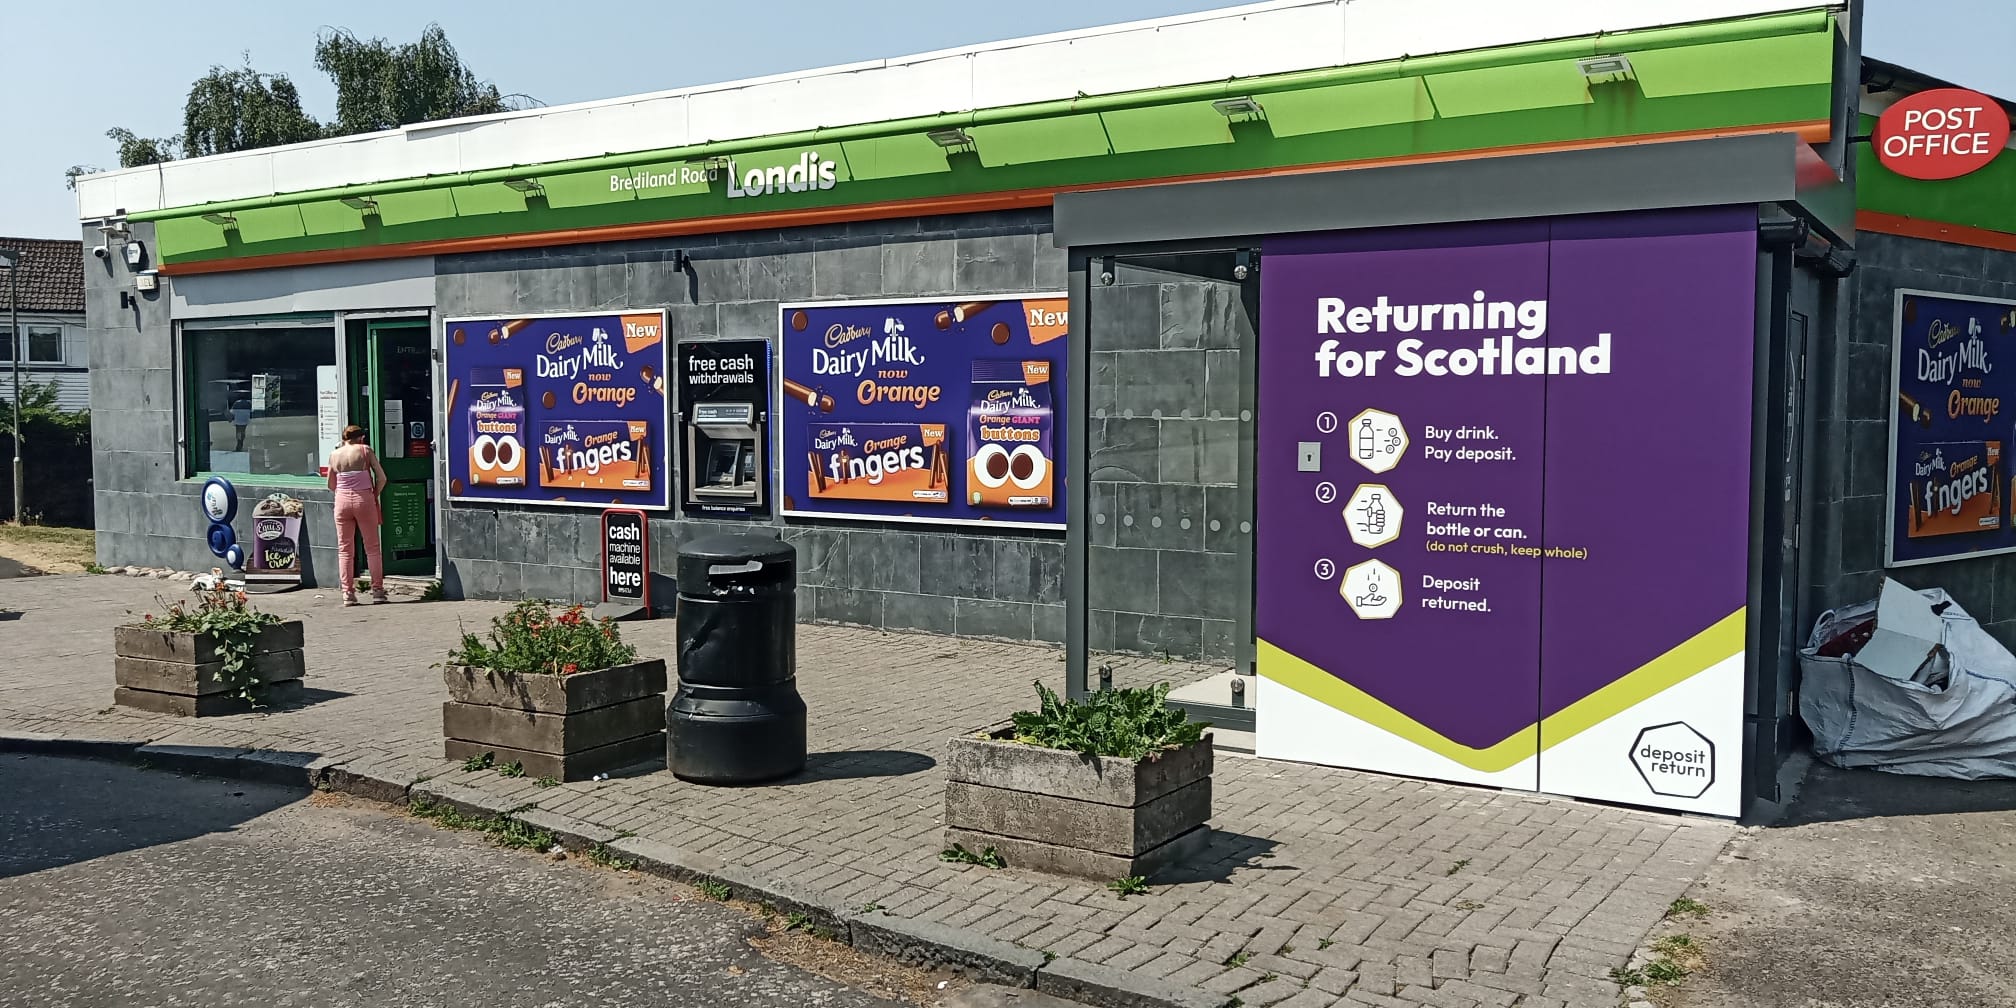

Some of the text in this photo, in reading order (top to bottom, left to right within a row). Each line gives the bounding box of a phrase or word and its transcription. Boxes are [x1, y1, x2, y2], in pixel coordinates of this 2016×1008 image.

[1904, 107, 1983, 131] POST
[1883, 132, 1990, 157] OFFICE
[610, 165, 718, 192] Brediland Road
[727, 151, 837, 199] Londis
[1317, 289, 1547, 339] Returning
[626, 323, 658, 338] New
[824, 323, 872, 348] Cadbury
[546, 333, 583, 354] Cadbury
[536, 343, 623, 380] Dairy Milk
[688, 353, 754, 372] free cash
[812, 336, 925, 377] Dairy Milk
[1315, 333, 1611, 377] for Scotland
[1918, 338, 1992, 386] Dairy Milk
[588, 373, 611, 381] now
[689, 371, 754, 384] withdrawals
[878, 369, 908, 379] now
[1027, 365, 1049, 374] New
[477, 400, 497, 411] Dairy
[497, 395, 517, 407] Milk
[572, 382, 636, 408] Orange
[857, 380, 941, 410] Orange
[980, 395, 1041, 413] Dairy Milk
[1948, 389, 2000, 423] Orange
[477, 420, 517, 433] buttons
[980, 414, 1041, 425] Orange GIANT
[544, 431, 580, 444] Dairy Milk
[584, 431, 618, 447] Orange
[923, 428, 943, 437] New
[980, 425, 1041, 441] buttons
[1425, 425, 1499, 442] Buy drink.
[815, 434, 858, 450] Dairy Milk
[863, 435, 907, 454] Orange
[556, 440, 632, 475] fingers
[1425, 445, 1516, 463] Pay deposit.
[829, 446, 925, 485] fingers
[1915, 462, 1932, 476] Dairy
[1925, 467, 1988, 517] fingers
[1427, 502, 1505, 517] Return the
[609, 523, 640, 540] cash
[1426, 522, 1527, 539] bottle or can.
[265, 550, 281, 561] Ice
[609, 542, 641, 554] machine
[1426, 540, 1588, 560] (do not crush, keep whole)
[609, 554, 641, 565] available
[610, 566, 641, 587] here
[1422, 574, 1480, 592] Deposit
[1422, 596, 1491, 612] returned.
[1640, 744, 1706, 764] deposit
[1651, 761, 1706, 777] return
